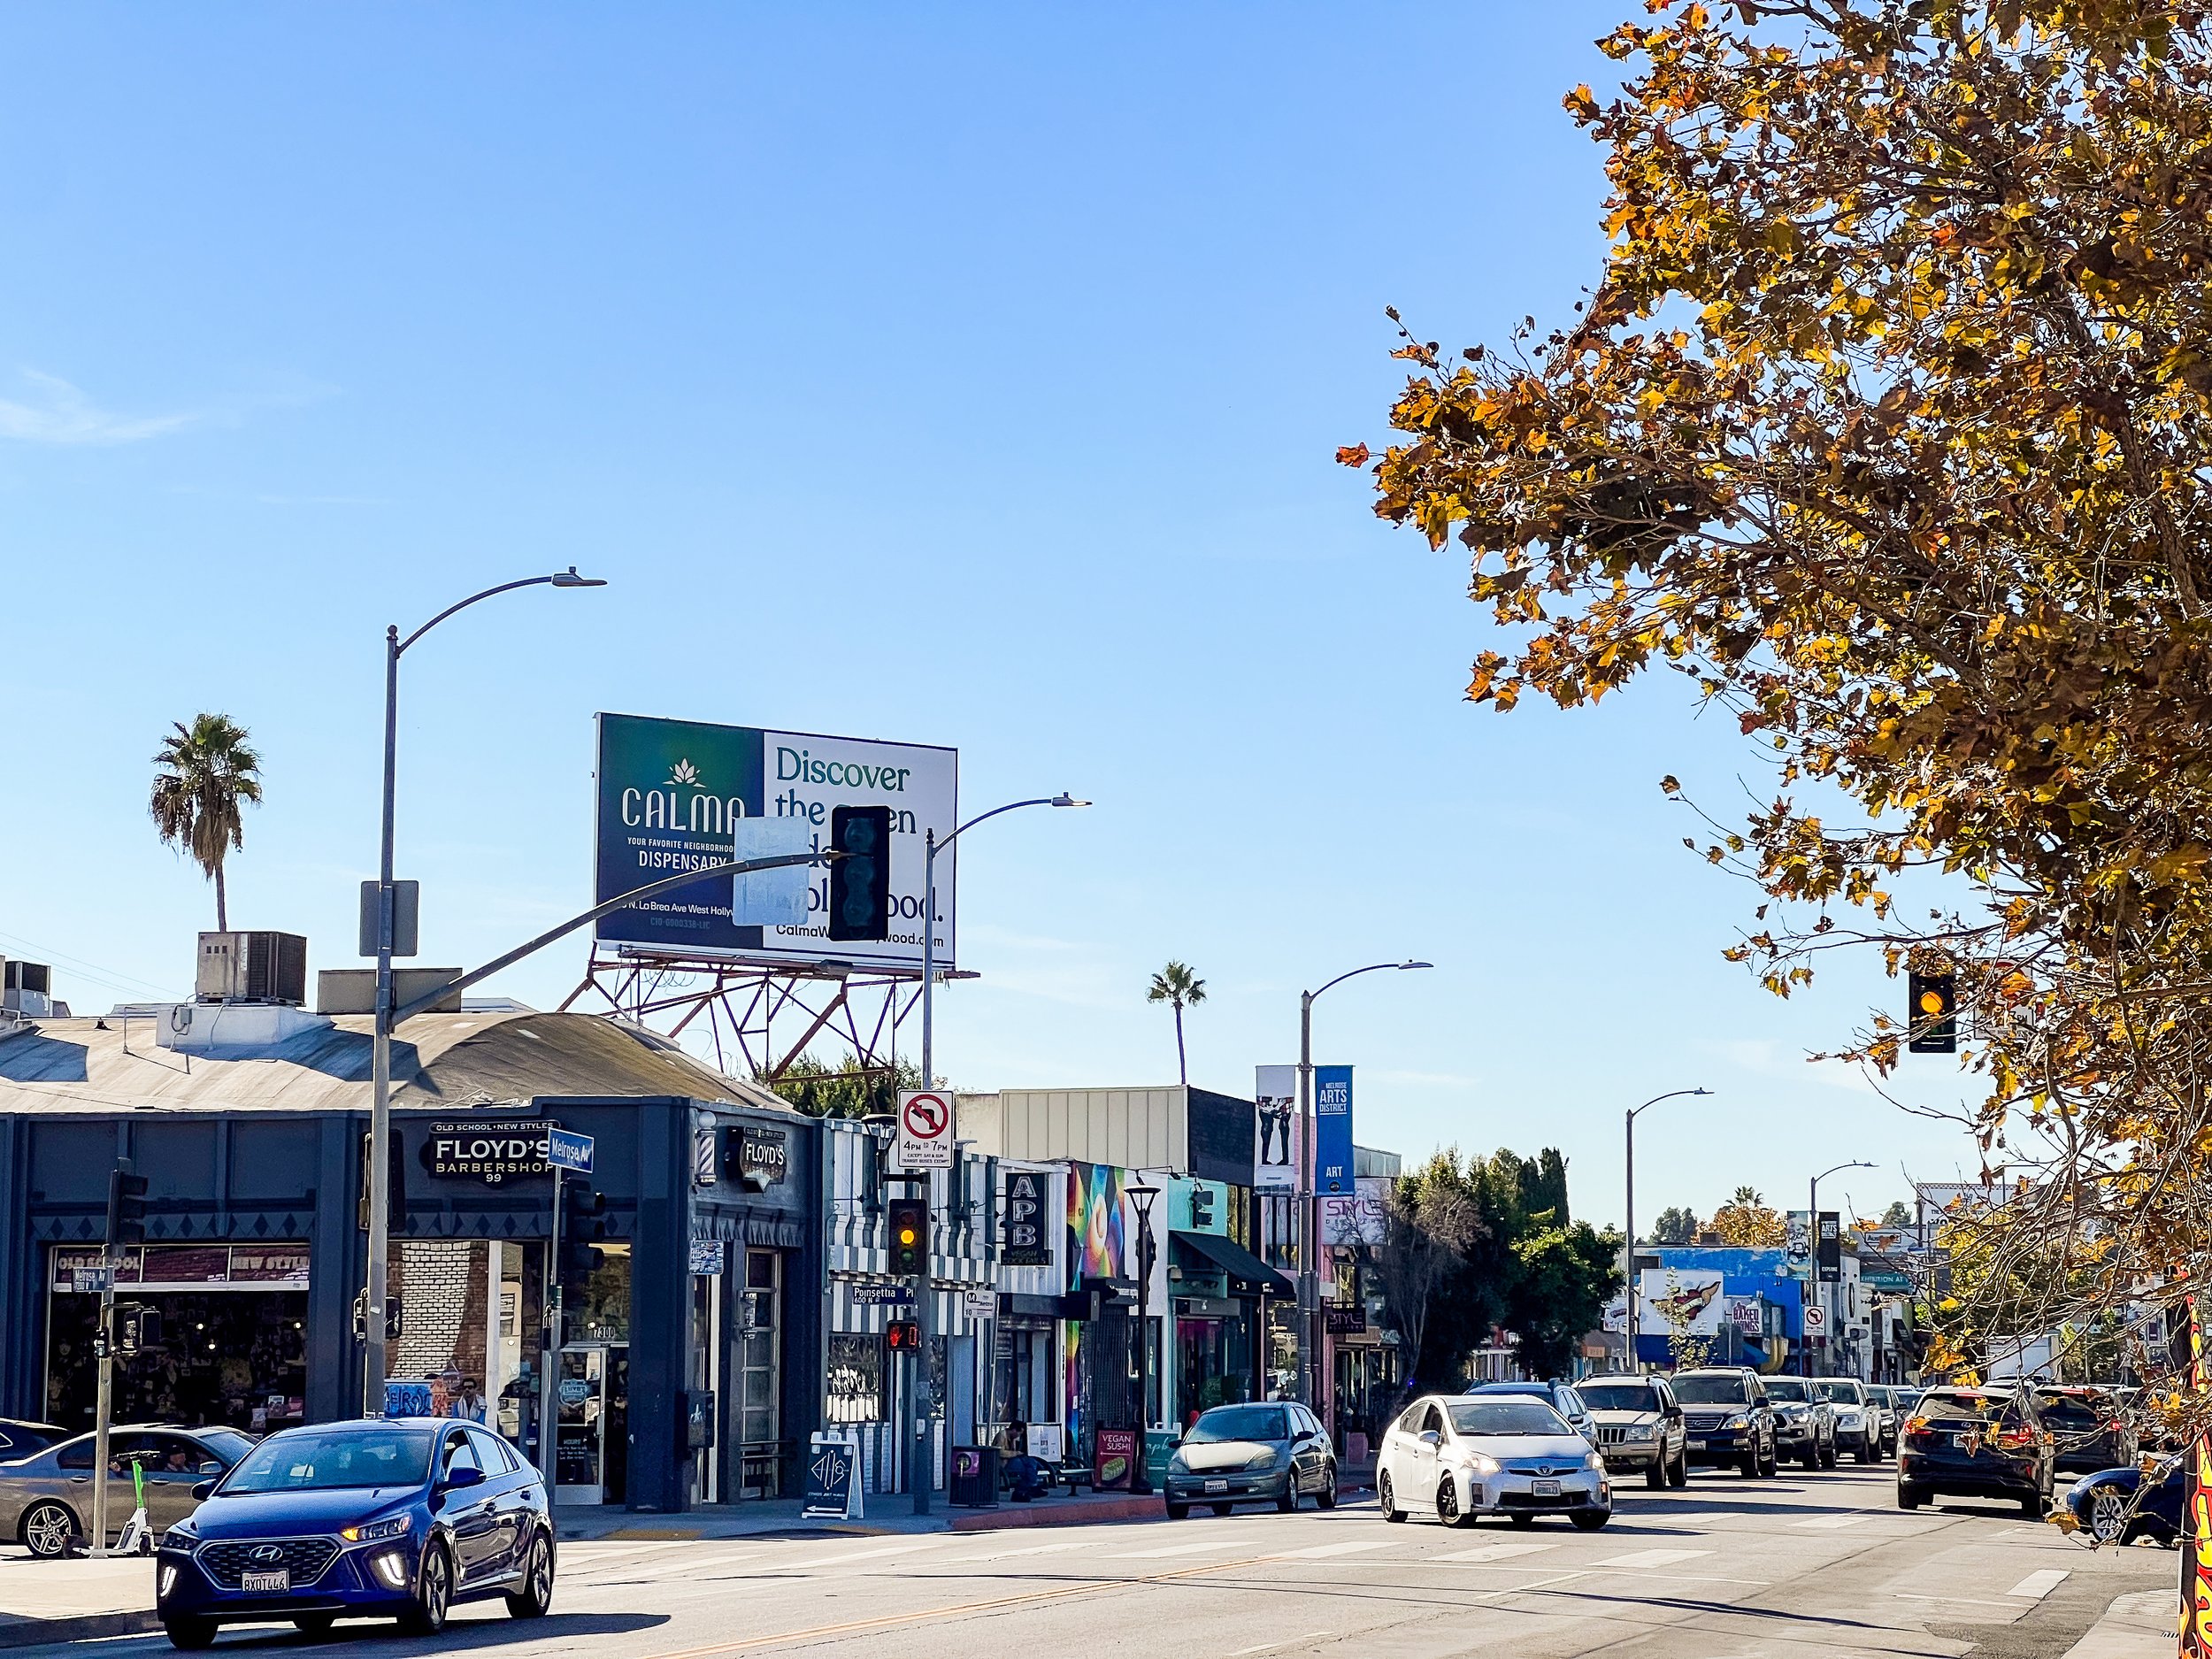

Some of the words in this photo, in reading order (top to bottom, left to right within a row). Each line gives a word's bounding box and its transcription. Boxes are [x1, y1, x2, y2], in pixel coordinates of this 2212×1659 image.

[776, 747, 910, 792] Discover
[622, 787, 746, 834] CALMA
[775, 788, 826, 826] the
[627, 836, 647, 846] YOUR
[648, 838, 681, 849] FAVORITE
[683, 841, 734, 853] NEIGHBORHOO
[639, 901, 649, 910] La
[650, 902, 670, 911] Brea
[671, 903, 687, 913] Ave
[688, 904, 710, 915] West
[1320, 1089, 1348, 1103] ARTS
[1319, 1103, 1347, 1112] DISTRICT
[436, 1140, 549, 1159] FLOYD'S
[551, 1138, 580, 1162] Melrose
[580, 1145, 590, 1164] Av
[903, 1141, 921, 1150] 4PM
[931, 1141, 948, 1151] 7PM
[746, 1143, 785, 1166] FLOYD'S
[435, 1163, 554, 1172] BARBERSHOP
[1325, 1166, 1343, 1178] ART
[486, 1173, 502, 1182] 99
[1012, 1176, 1037, 1246] APB
[854, 1287, 896, 1298] Poinsettia
[905, 1287, 914, 1298] Pl
[1733, 1309, 1759, 1321] BAKED
[594, 1327, 616, 1339] 7300
[1102, 1434, 1132, 1443] VEGAN
